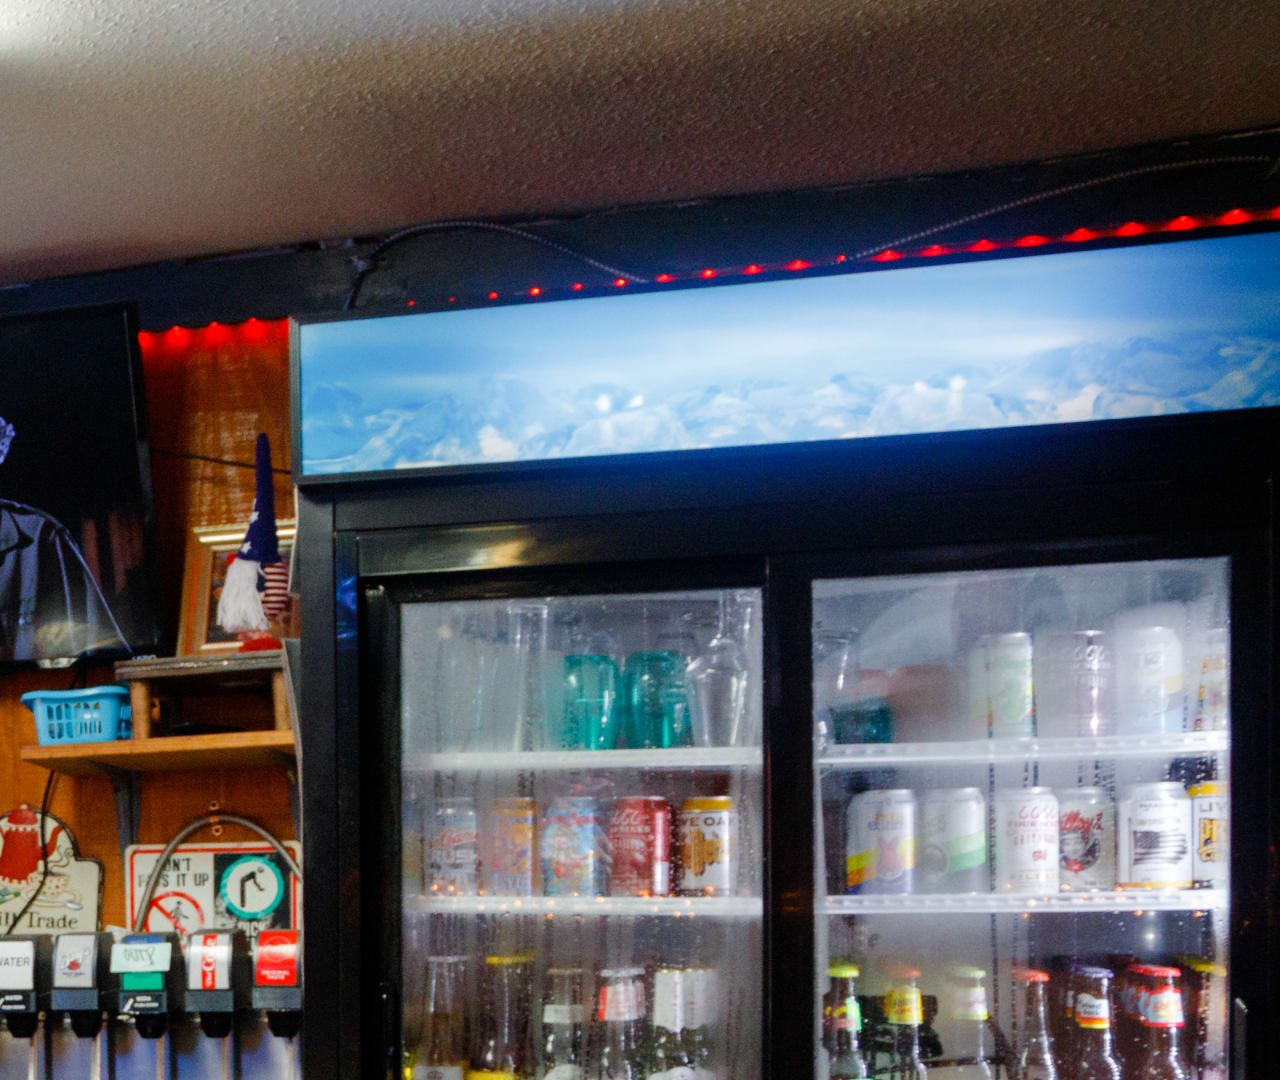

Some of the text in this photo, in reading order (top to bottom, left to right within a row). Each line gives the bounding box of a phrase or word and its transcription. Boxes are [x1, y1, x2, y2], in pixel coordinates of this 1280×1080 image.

[177, 872, 210, 887] IT UP
[27, 908, 78, 930] Trade
